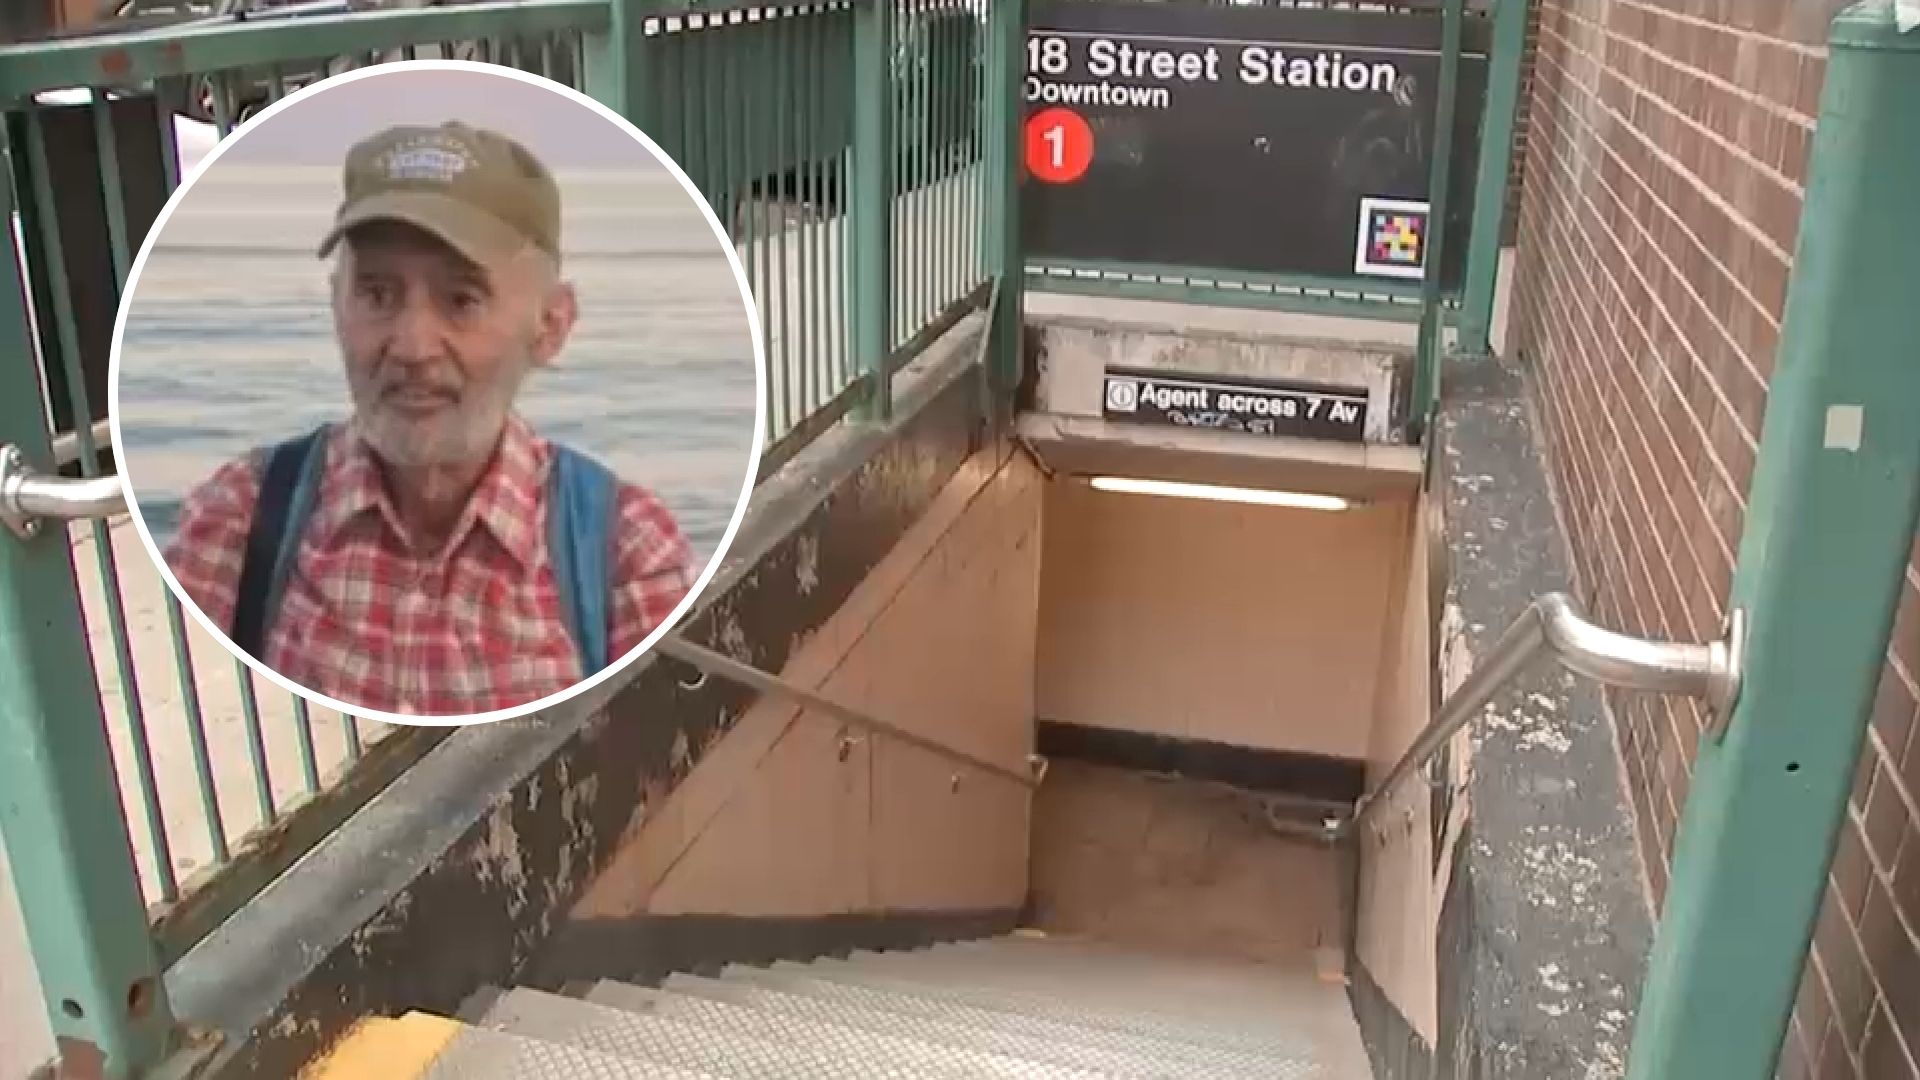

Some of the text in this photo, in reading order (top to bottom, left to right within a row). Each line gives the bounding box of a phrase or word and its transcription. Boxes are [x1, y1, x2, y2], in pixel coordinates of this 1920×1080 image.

[1027, 37, 1396, 92] 18 Street Station
[1026, 76, 1169, 108] Downtown
[1043, 125, 1065, 167] 1
[1140, 383, 1359, 424] Agent across 7 Av
